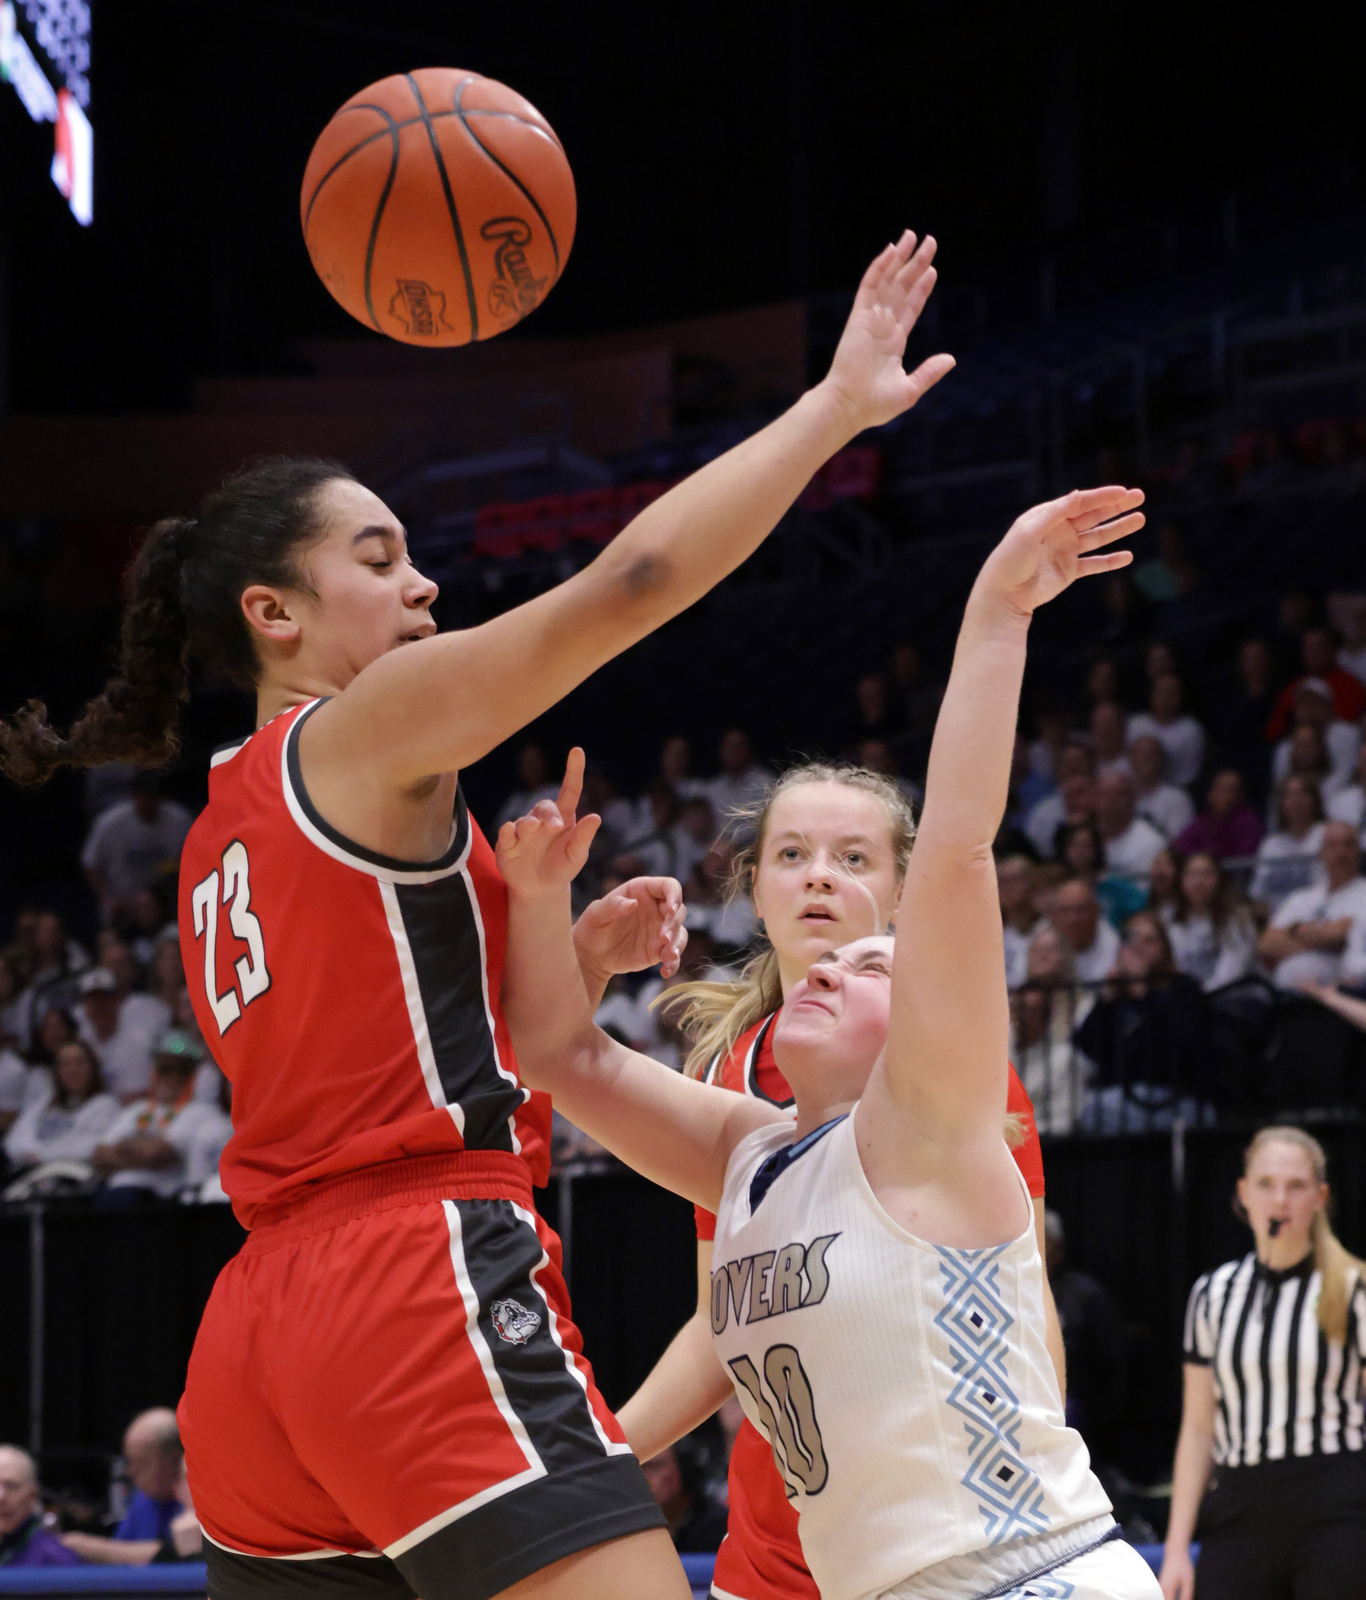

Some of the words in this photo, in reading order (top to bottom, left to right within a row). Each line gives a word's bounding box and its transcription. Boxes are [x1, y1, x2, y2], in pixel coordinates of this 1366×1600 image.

[192, 837, 273, 1038] 23
[710, 1231, 843, 1339] OVERS
[728, 1343, 829, 1499] 10
